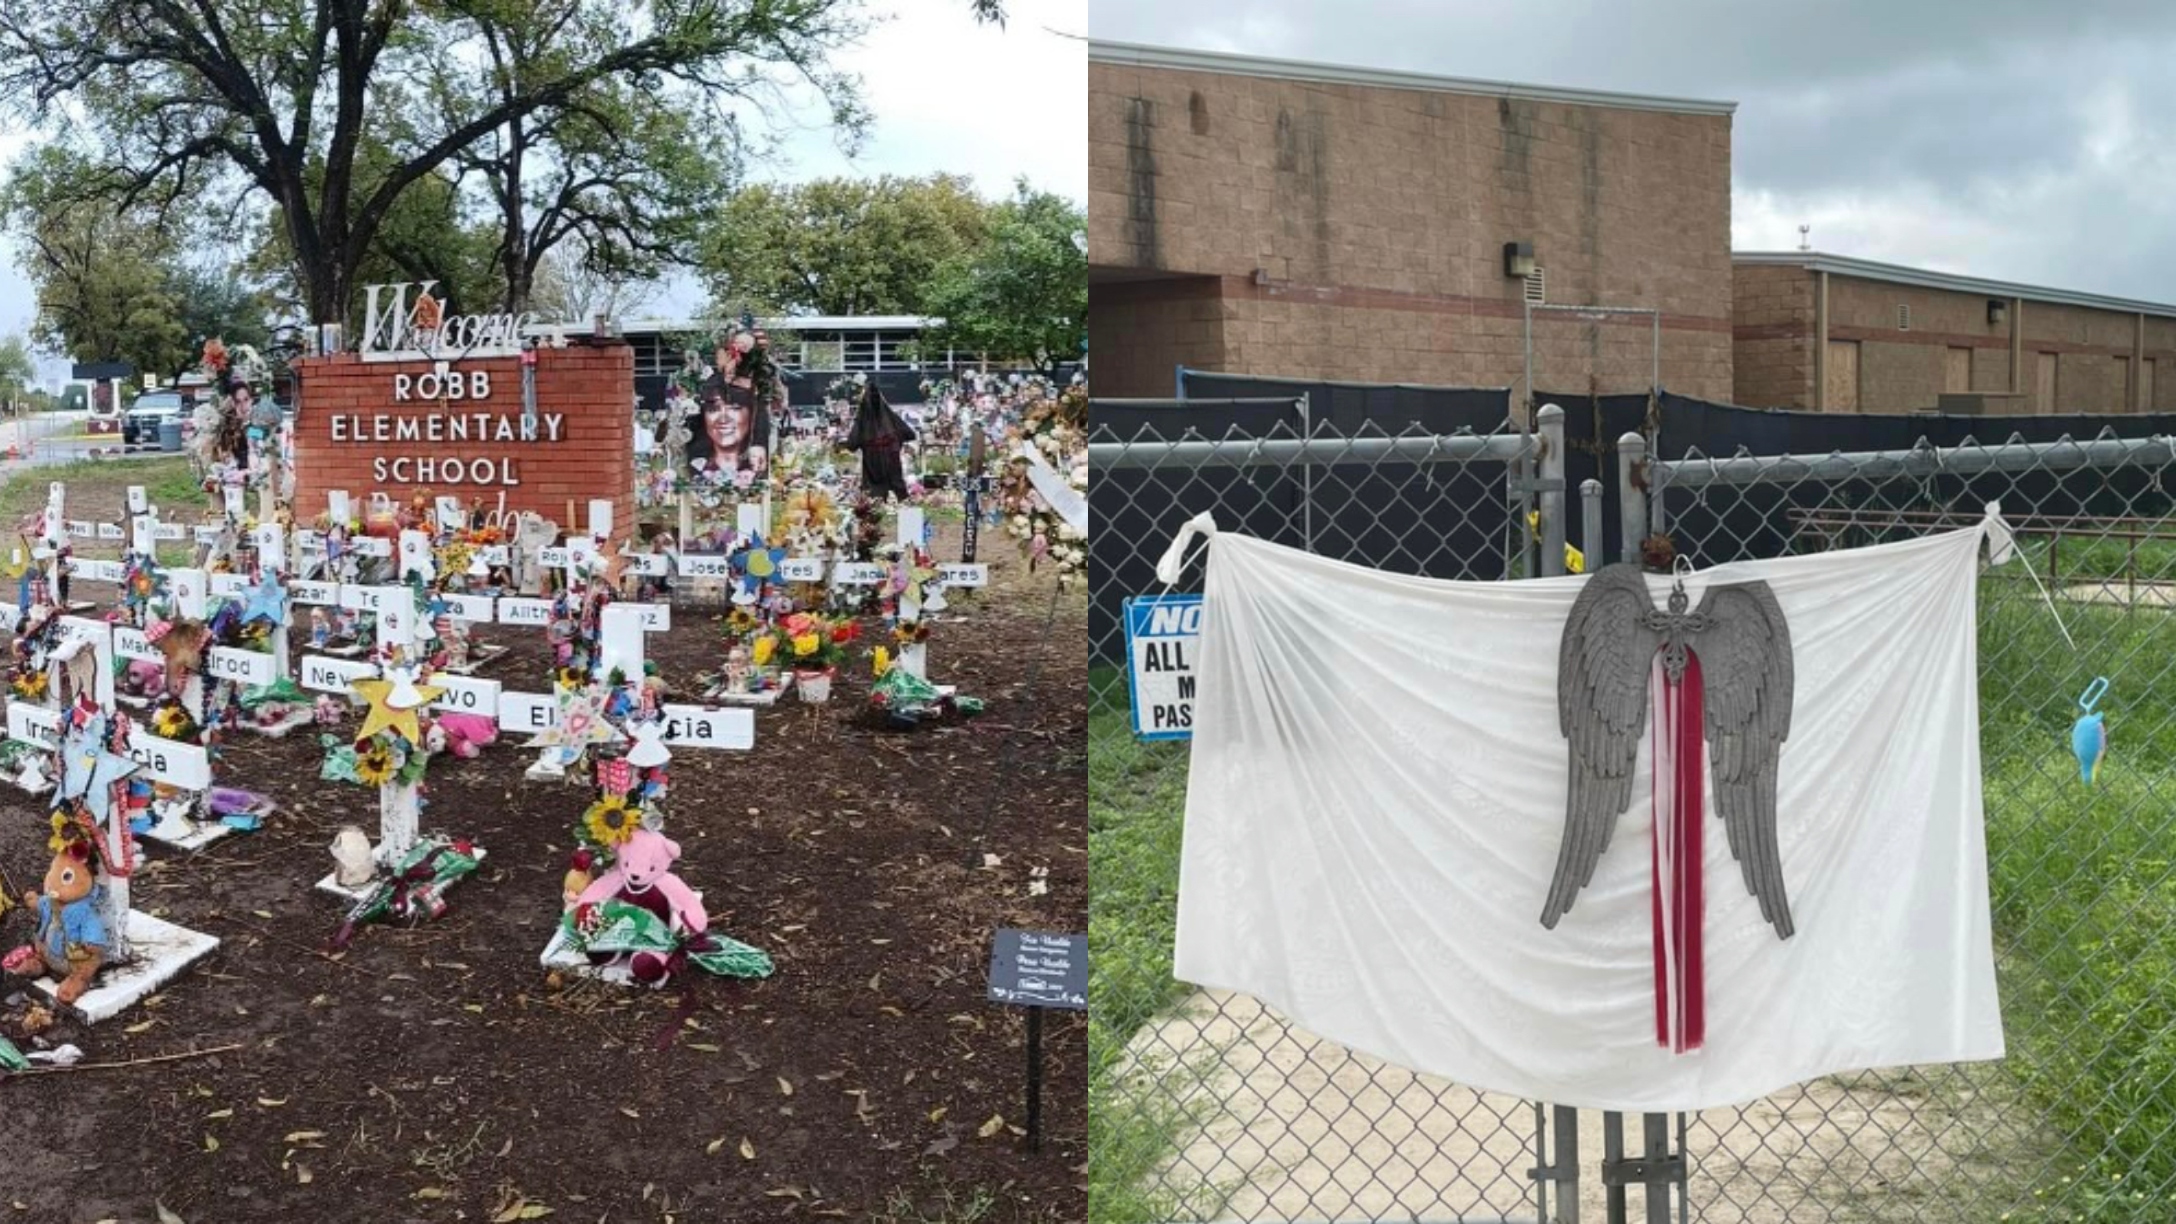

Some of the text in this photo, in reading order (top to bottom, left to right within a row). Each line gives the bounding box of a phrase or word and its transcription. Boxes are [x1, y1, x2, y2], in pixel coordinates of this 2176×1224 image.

[361, 280, 534, 352] Wlcome
[395, 371, 490, 401] ROBB
[331, 413, 563, 441] ELEMENTARY
[373, 457, 519, 485] SCHOOL
[688, 559, 725, 575] Jose
[1145, 641, 1190, 672] ALL
[1153, 703, 1193, 729] PAS
